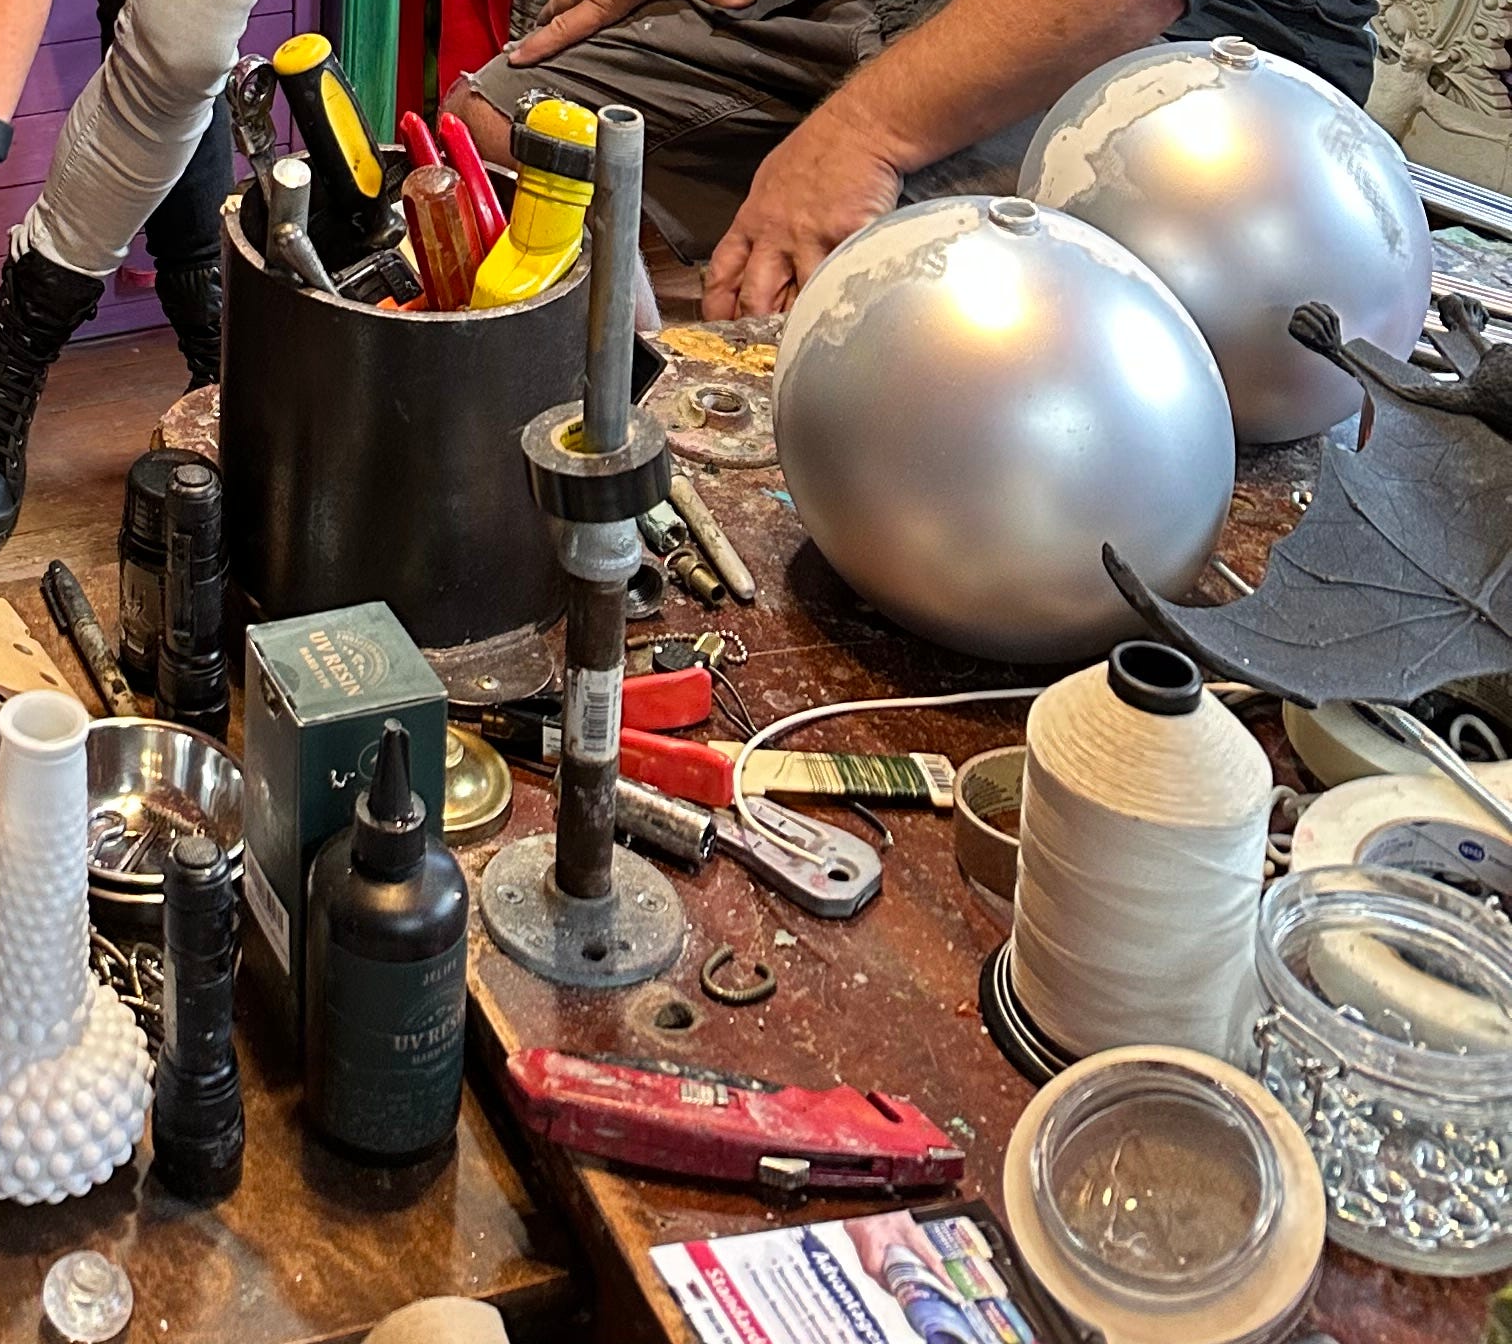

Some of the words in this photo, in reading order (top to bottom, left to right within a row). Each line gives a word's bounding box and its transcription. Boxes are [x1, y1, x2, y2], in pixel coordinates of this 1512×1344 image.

[308, 630, 336, 652] UV
[322, 652, 362, 698] RESIN
[393, 1034, 425, 1052] UV
[811, 1250, 886, 1344] Advantage
